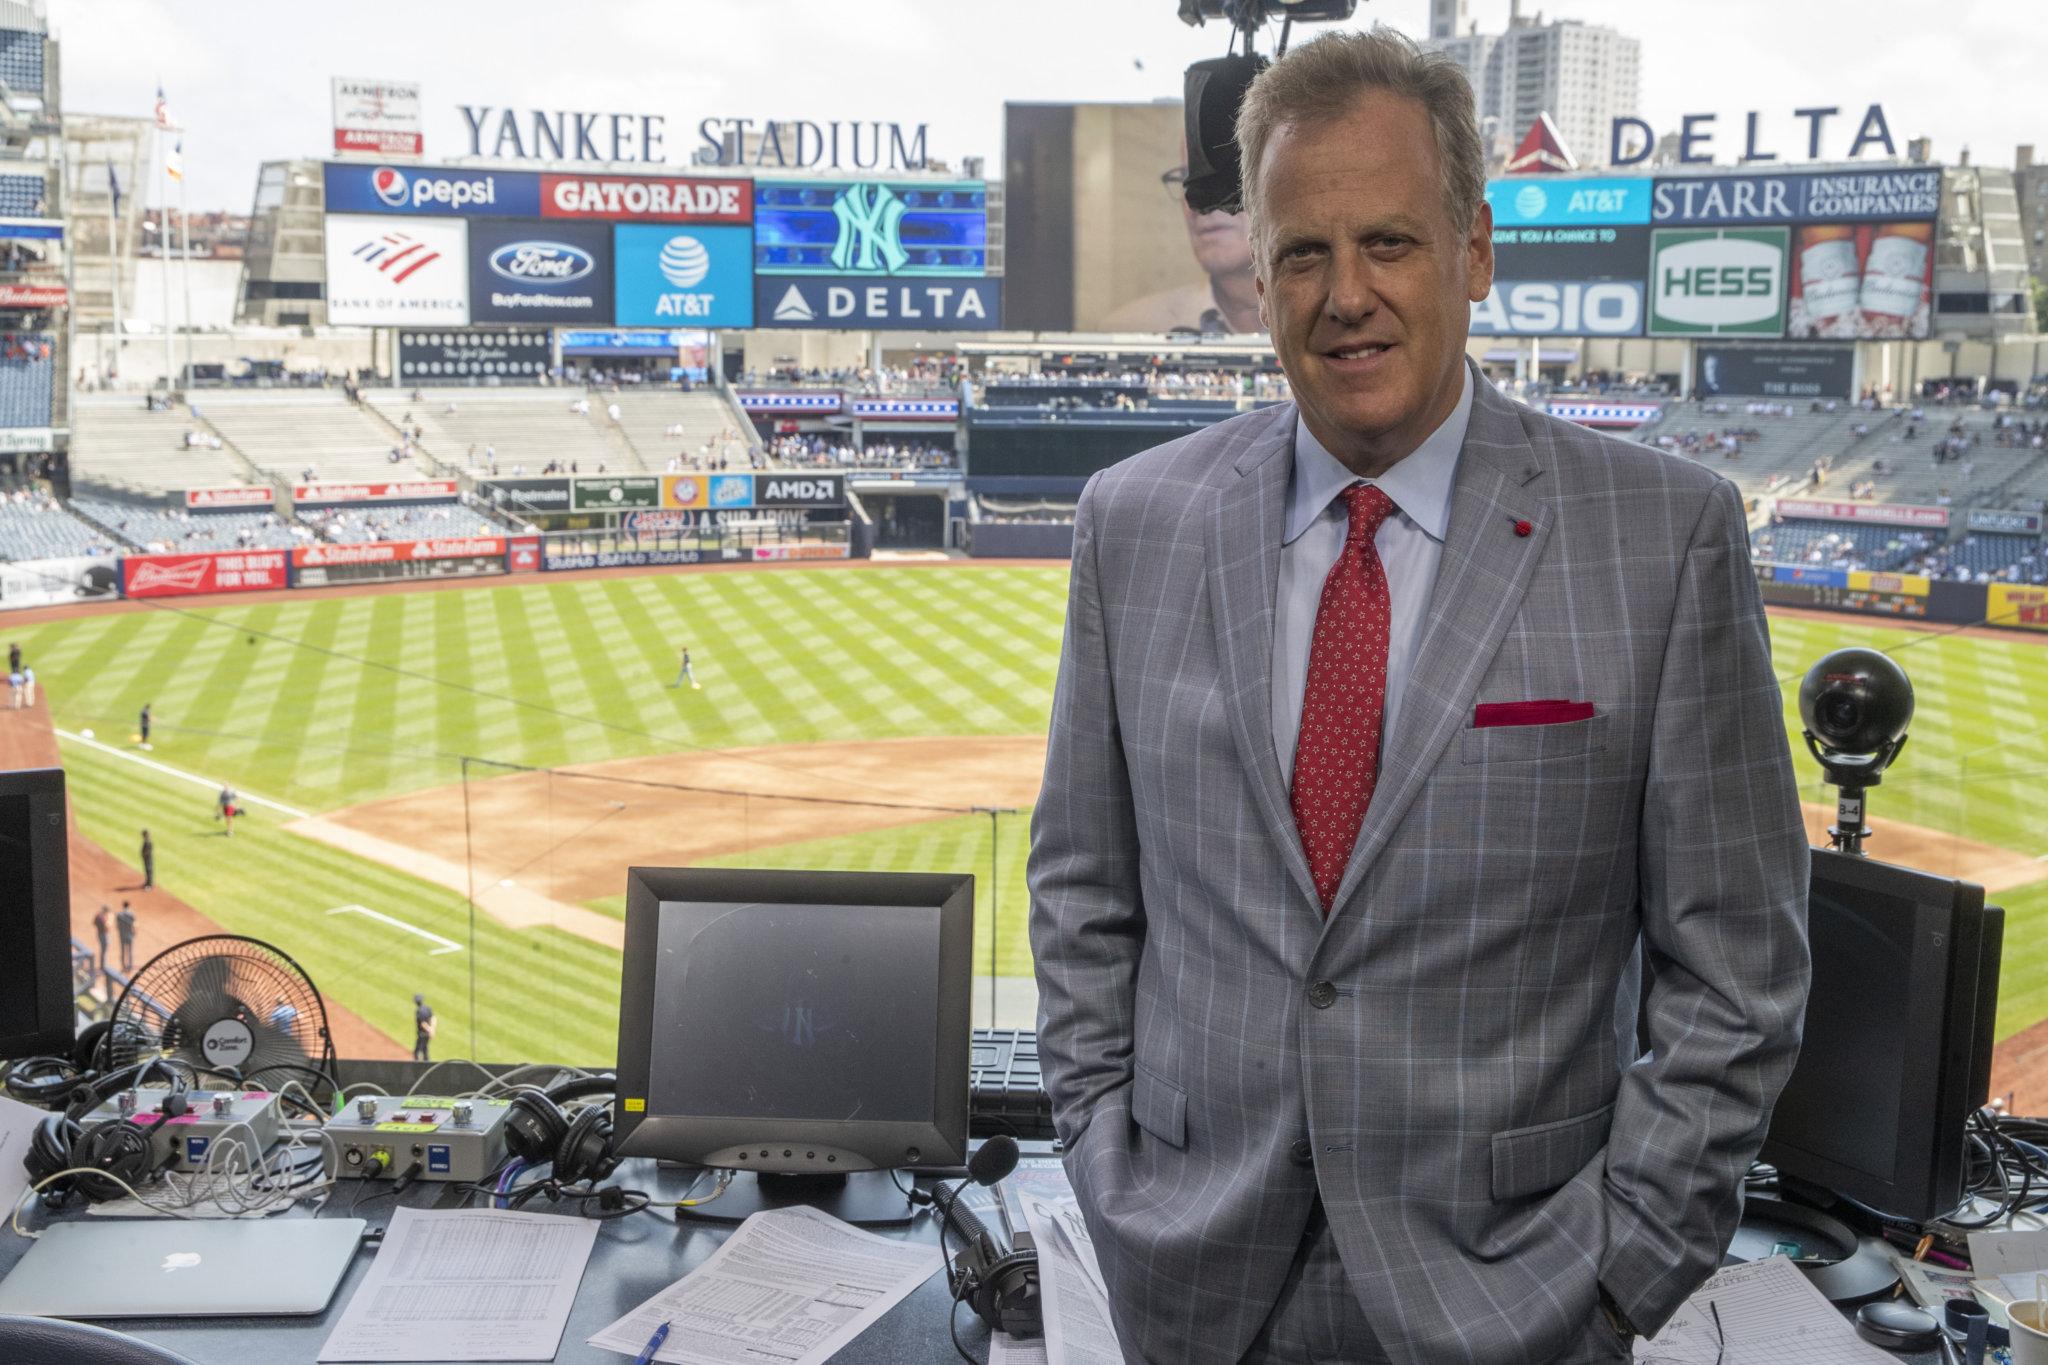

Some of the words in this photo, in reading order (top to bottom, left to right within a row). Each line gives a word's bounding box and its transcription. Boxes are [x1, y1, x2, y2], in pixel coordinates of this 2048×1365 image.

[457, 105, 666, 163] YANKEE
[699, 118, 929, 170] STADIUM
[1611, 103, 1896, 165] DELTA
[413, 177, 495, 208] pepsi
[554, 182, 740, 214] GATORADE
[1653, 179, 1792, 219] STARR
[1811, 172, 1939, 196] INSURANCE
[1567, 189, 1628, 213] AT&T
[1808, 193, 1937, 217] COMPANIES
[1520, 230, 1543, 243] YOU
[1544, 230, 1553, 242] A
[1554, 229, 1597, 243] CHANCE
[1599, 229, 1616, 242] TO
[511, 247, 574, 275] Ford
[1665, 267, 1772, 297] HESS
[655, 293, 714, 316] AT&T
[828, 288, 986, 318] DELTA
[1470, 283, 1639, 333] ASIO
[765, 481, 816, 499] AMD
